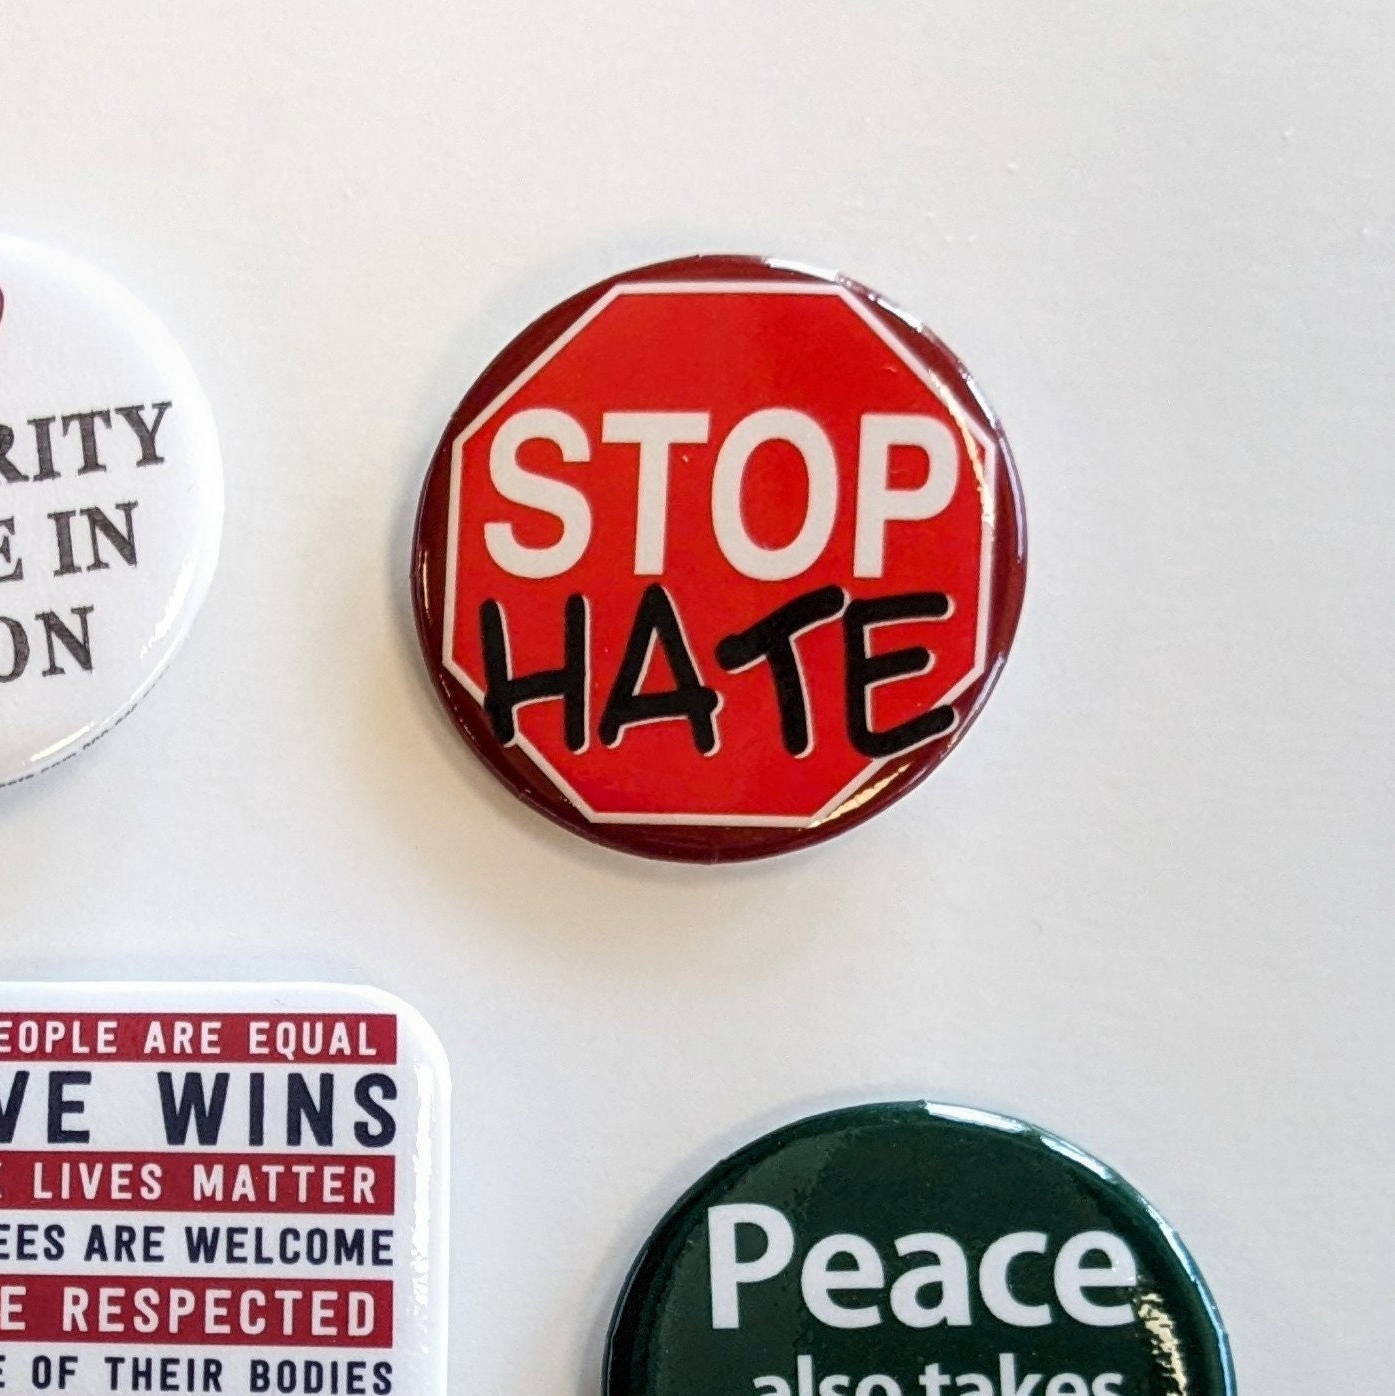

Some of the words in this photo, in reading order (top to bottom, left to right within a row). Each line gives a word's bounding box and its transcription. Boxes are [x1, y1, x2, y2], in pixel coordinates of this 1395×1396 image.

[483, 407, 959, 581] STOP
[47, 501, 139, 577] IN
[479, 582, 959, 759] HATE
[144, 1021, 223, 1055] ARE
[248, 1021, 377, 1061] EQUAL
[158, 1070, 398, 1148] WINS
[34, 1163, 162, 1200] LIVES
[193, 1164, 376, 1204] MATTER
[84, 1225, 165, 1263] ARE
[185, 1226, 395, 1267] WELCOME
[706, 1203, 1138, 1330] Peace
[62, 1286, 375, 1337] RESPECTED
[32, 1355, 78, 1390] OF
[105, 1356, 223, 1393] THEIR
[249, 1359, 393, 1396] BODIES
